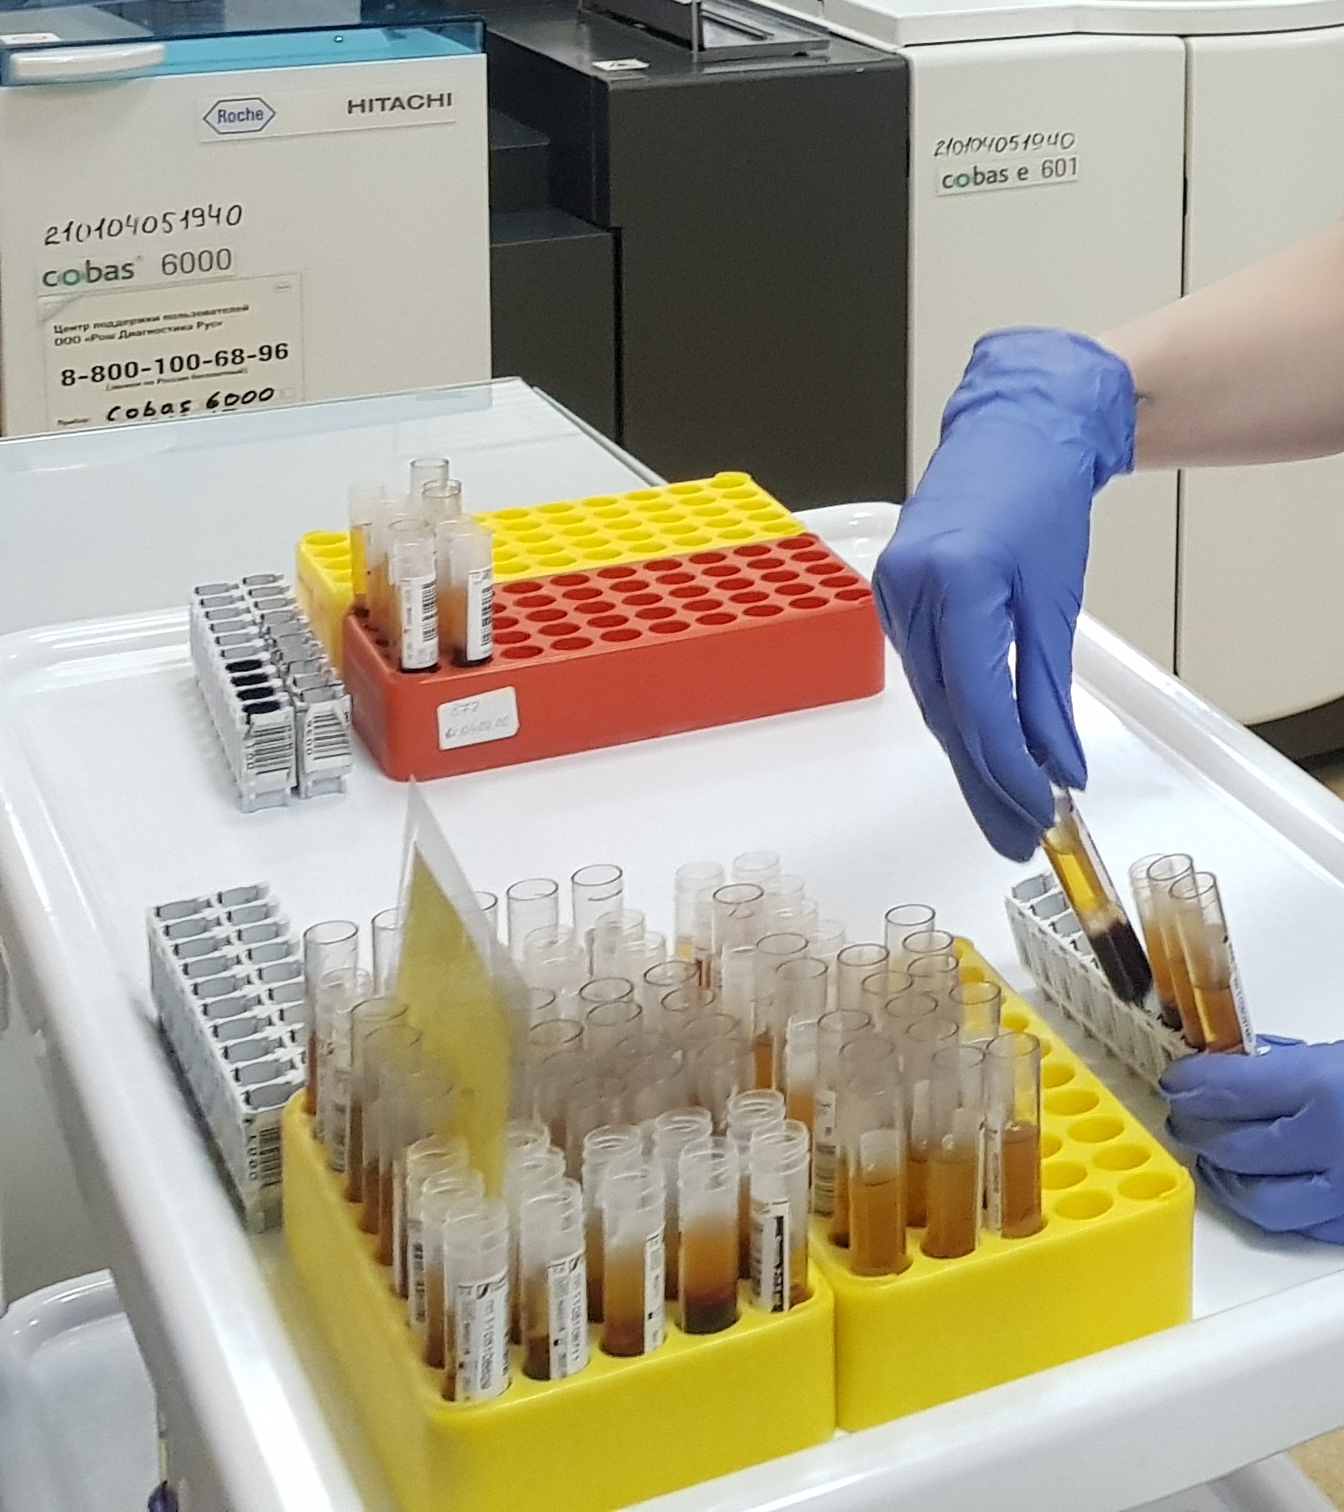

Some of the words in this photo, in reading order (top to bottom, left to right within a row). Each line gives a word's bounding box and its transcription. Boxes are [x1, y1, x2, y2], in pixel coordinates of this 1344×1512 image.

[217, 107, 264, 124] Roche
[347, 93, 453, 115] HITACHI
[942, 165, 1009, 189] cobas
[1017, 166, 1029, 181] e
[1041, 157, 1077, 179] 601
[44, 204, 243, 246] 210104051940
[42, 259, 135, 287] cobas
[161, 248, 232, 276] 6000
[53, 322, 90, 335] Центр
[54, 335, 82, 347] ООО
[118, 324, 194, 341] Диагностика
[61, 342, 290, 387] 8-800-100-68-96
[206, 387, 275, 410] 6000
